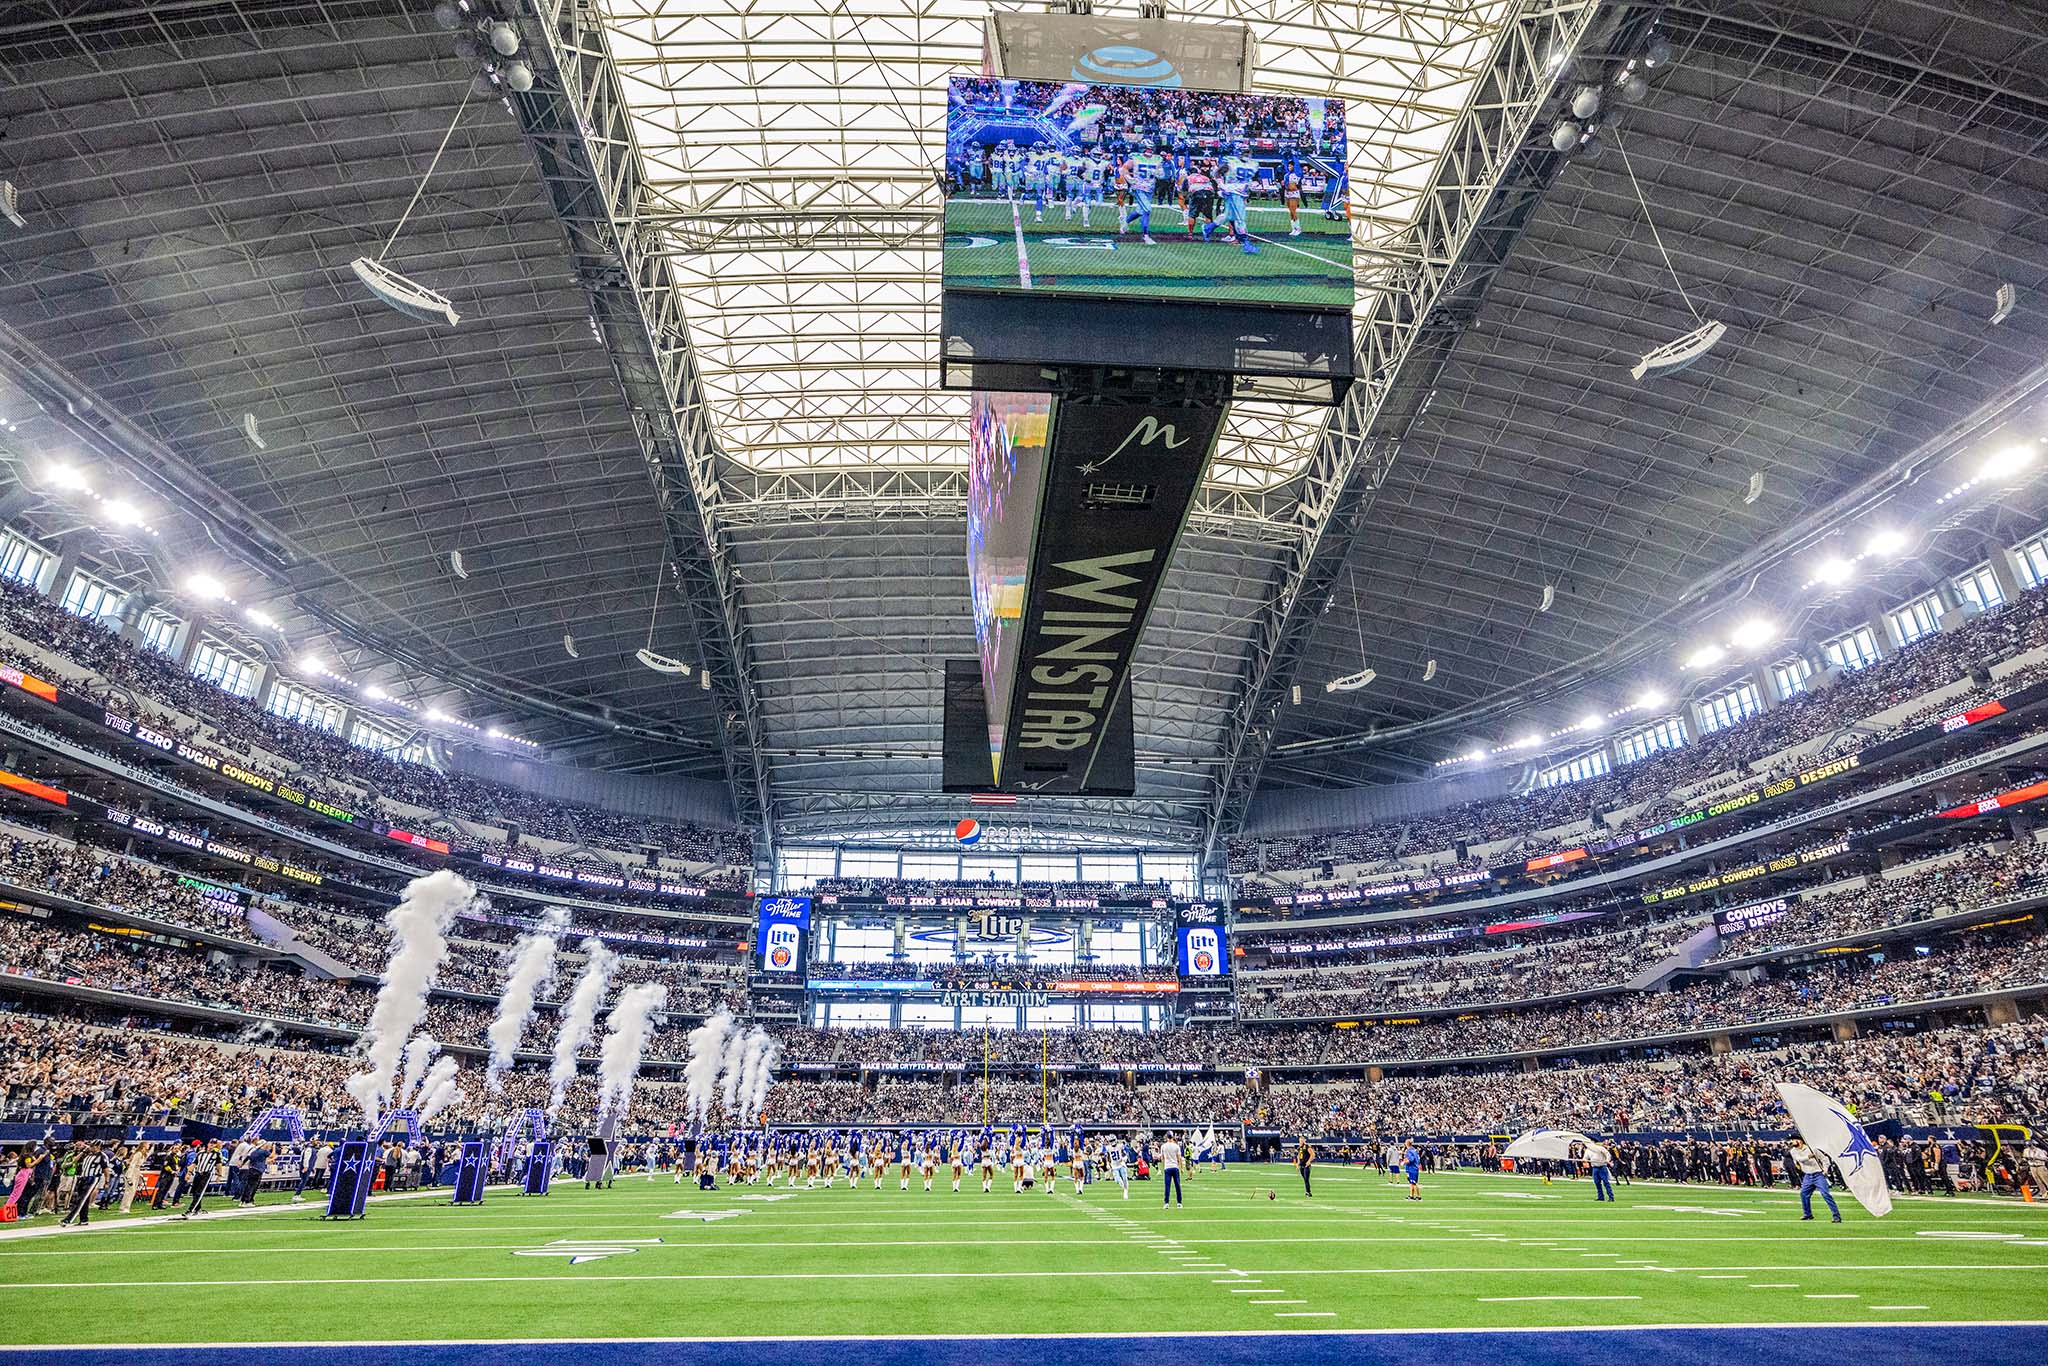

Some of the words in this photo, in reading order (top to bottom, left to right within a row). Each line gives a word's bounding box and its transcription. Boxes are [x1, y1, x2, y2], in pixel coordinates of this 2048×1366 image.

[1018, 548, 1157, 751] WINSTAR
[0, 721, 35, 740] STAUBACH
[105, 712, 132, 733] THE
[136, 727, 173, 750] ZERO
[177, 744, 218, 770] SUGAR
[222, 764, 273, 792] COWBOYS
[277, 786, 305, 804] FANS
[308, 799, 354, 823] DESERVE
[1912, 778, 1920, 786] 94
[1921, 767, 1953, 782] CHARLES
[1954, 758, 1978, 771] HALEY
[136, 772, 148, 783] LEE
[148, 777, 159, 787] ROY
[160, 781, 182, 796] JORDAN
[1616, 834, 1636, 846] THE
[1639, 825, 1666, 838] ZERO
[1670, 812, 1704, 828] SUGAR
[1708, 792, 1759, 816] COWBOYS
[1764, 778, 1796, 798] FANS
[1800, 756, 1860, 784] DESERVE
[1782, 816, 1806, 828] DARREN
[1807, 806, 1838, 820] WOODSON
[986, 824, 1032, 843] pepsi
[107, 808, 130, 825] THE
[133, 818, 164, 835] ZERO
[168, 830, 204, 848] SUGAR
[207, 842, 251, 864] COWBOYS
[254, 856, 280, 873] FANS
[282, 866, 323, 885] DESERVE
[366, 856, 379, 864] TONY
[1662, 887, 1686, 900] ZERO
[1690, 878, 1719, 892] SUGAR
[1722, 866, 1766, 883] COWBOYS
[1769, 856, 1798, 872] FANS
[1800, 842, 1850, 863] DESERVE
[482, 854, 502, 866] THE
[506, 860, 534, 872] ZERO
[539, 866, 573, 879] SUGAR
[578, 874, 624, 887] COWBOYS
[628, 880, 656, 892] FANS
[661, 885, 706, 896] DESERVE
[1296, 894, 1323, 904] ZERO
[1327, 890, 1360, 900] SUGAR
[1364, 884, 1410, 896] COWBOYS
[1414, 878, 1440, 891] FANS
[1445, 871, 1490, 886] DESERVE
[886, 897, 906, 905] THE
[910, 898, 936, 906] ZERO
[941, 898, 973, 906] SUGAR
[977, 898, 1020, 906] COWBOYS
[1026, 898, 1050, 908] FANS
[1056, 899, 1099, 908] DESERVE
[1726, 900, 1786, 922] COWBOYS
[565, 926, 594, 936] SUGAR
[598, 932, 638, 942] COWBOYS
[668, 938, 707, 948] DESERVE
[770, 930, 796, 946] Lite
[978, 914, 1022, 940] Lite
[1719, 920, 1746, 934] FANS
[1190, 936, 1214, 950] Lite
[1290, 944, 1312, 952] ZERO
[1316, 943, 1344, 952] SUGAR
[1348, 940, 1386, 948] COWBOYS
[1416, 932, 1454, 942] DESERVE
[941, 992, 979, 1007] AT&T
[982, 992, 1048, 1007] STADIUM
[860, 1062, 880, 1070] MAKE
[881, 1062, 899, 1070] YOUR
[900, 1062, 926, 1070] CRYPTO
[927, 1062, 944, 1070] PLAY
[945, 1062, 966, 1070] TODAY
[1110, 1151, 1120, 1160] 21
[6, 1206, 17, 1219] 20
